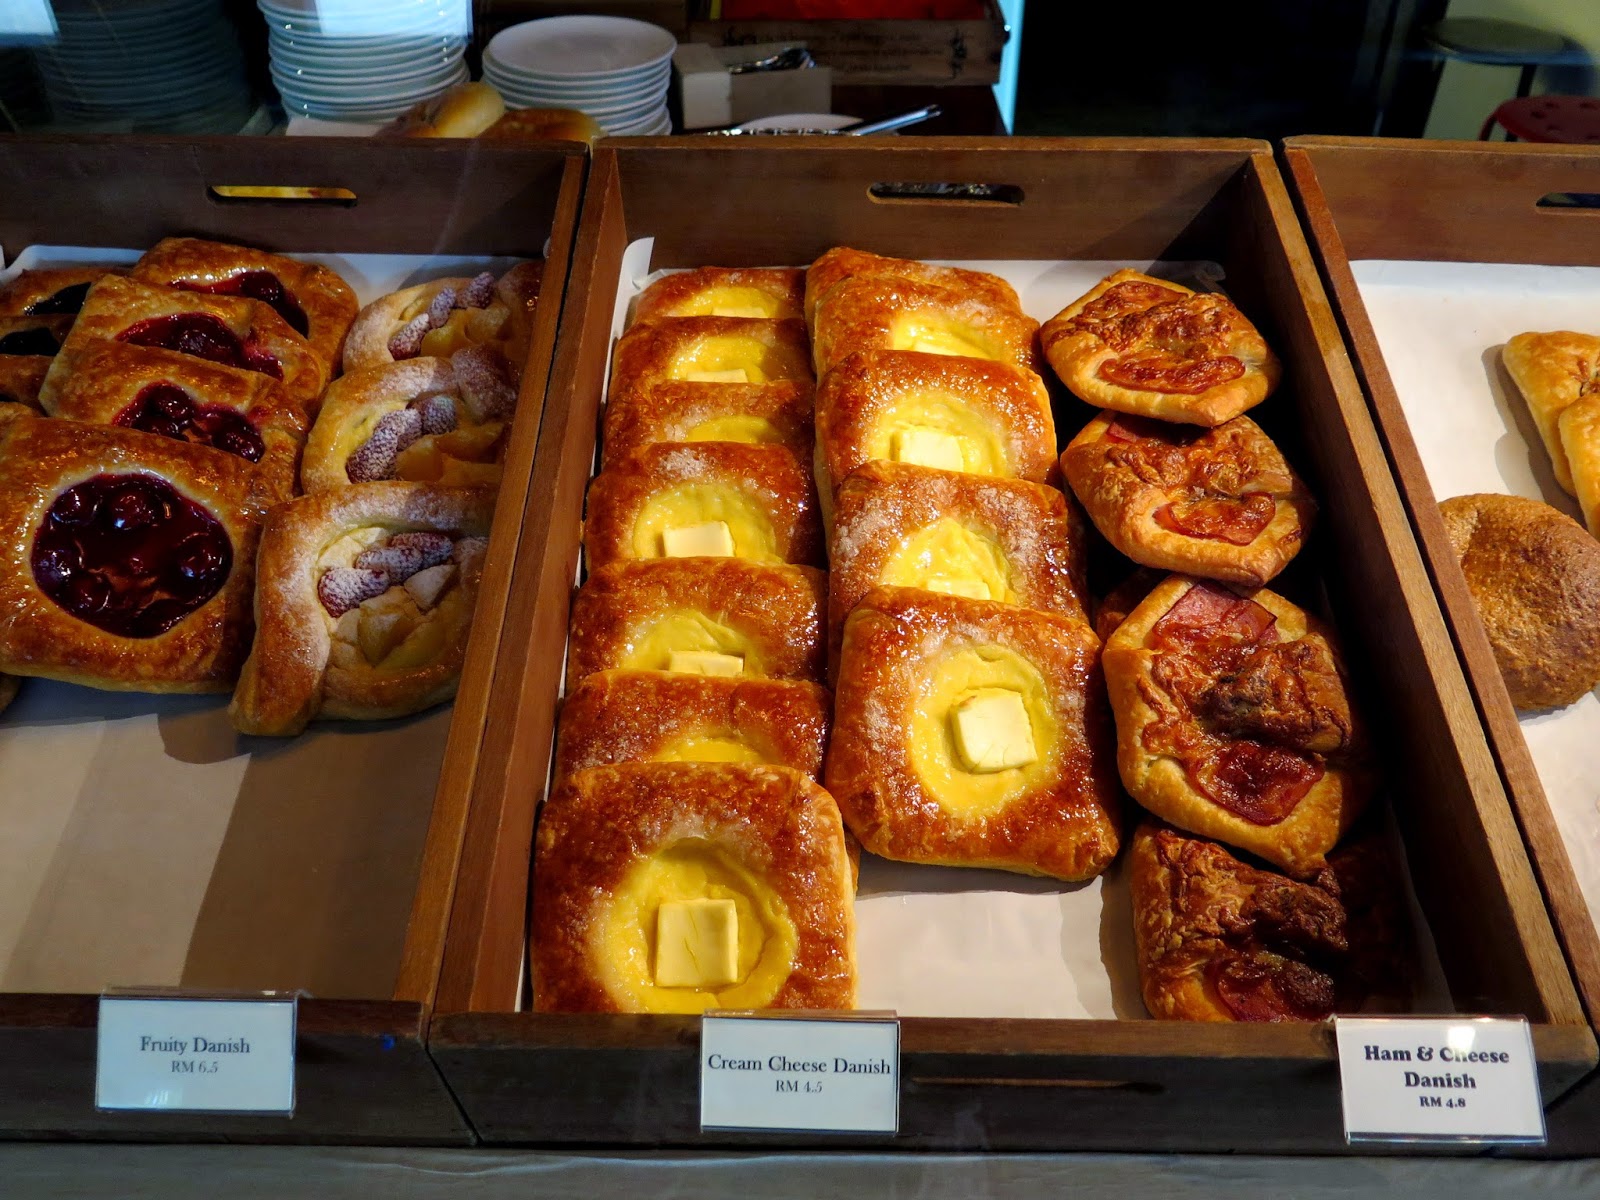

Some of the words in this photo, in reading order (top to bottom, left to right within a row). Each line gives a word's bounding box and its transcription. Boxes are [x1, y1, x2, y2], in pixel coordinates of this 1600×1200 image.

[140, 1036, 187, 1054] Fruity
[193, 1037, 250, 1053] Danish
[1364, 1045, 1411, 1061] Ham
[1417, 1046, 1434, 1061] &
[171, 1060, 194, 1073] RM
[198, 1060, 218, 1073] 6.5
[708, 1054, 762, 1070] Cream
[768, 1056, 827, 1073] Cheese
[833, 1058, 891, 1074] Danish
[775, 1080, 799, 1093] RM
[804, 1081, 823, 1093] 4.5
[1404, 1071, 1477, 1089] Danish
[1419, 1096, 1442, 1107] RM
[1445, 1097, 1466, 1108] 4.8
